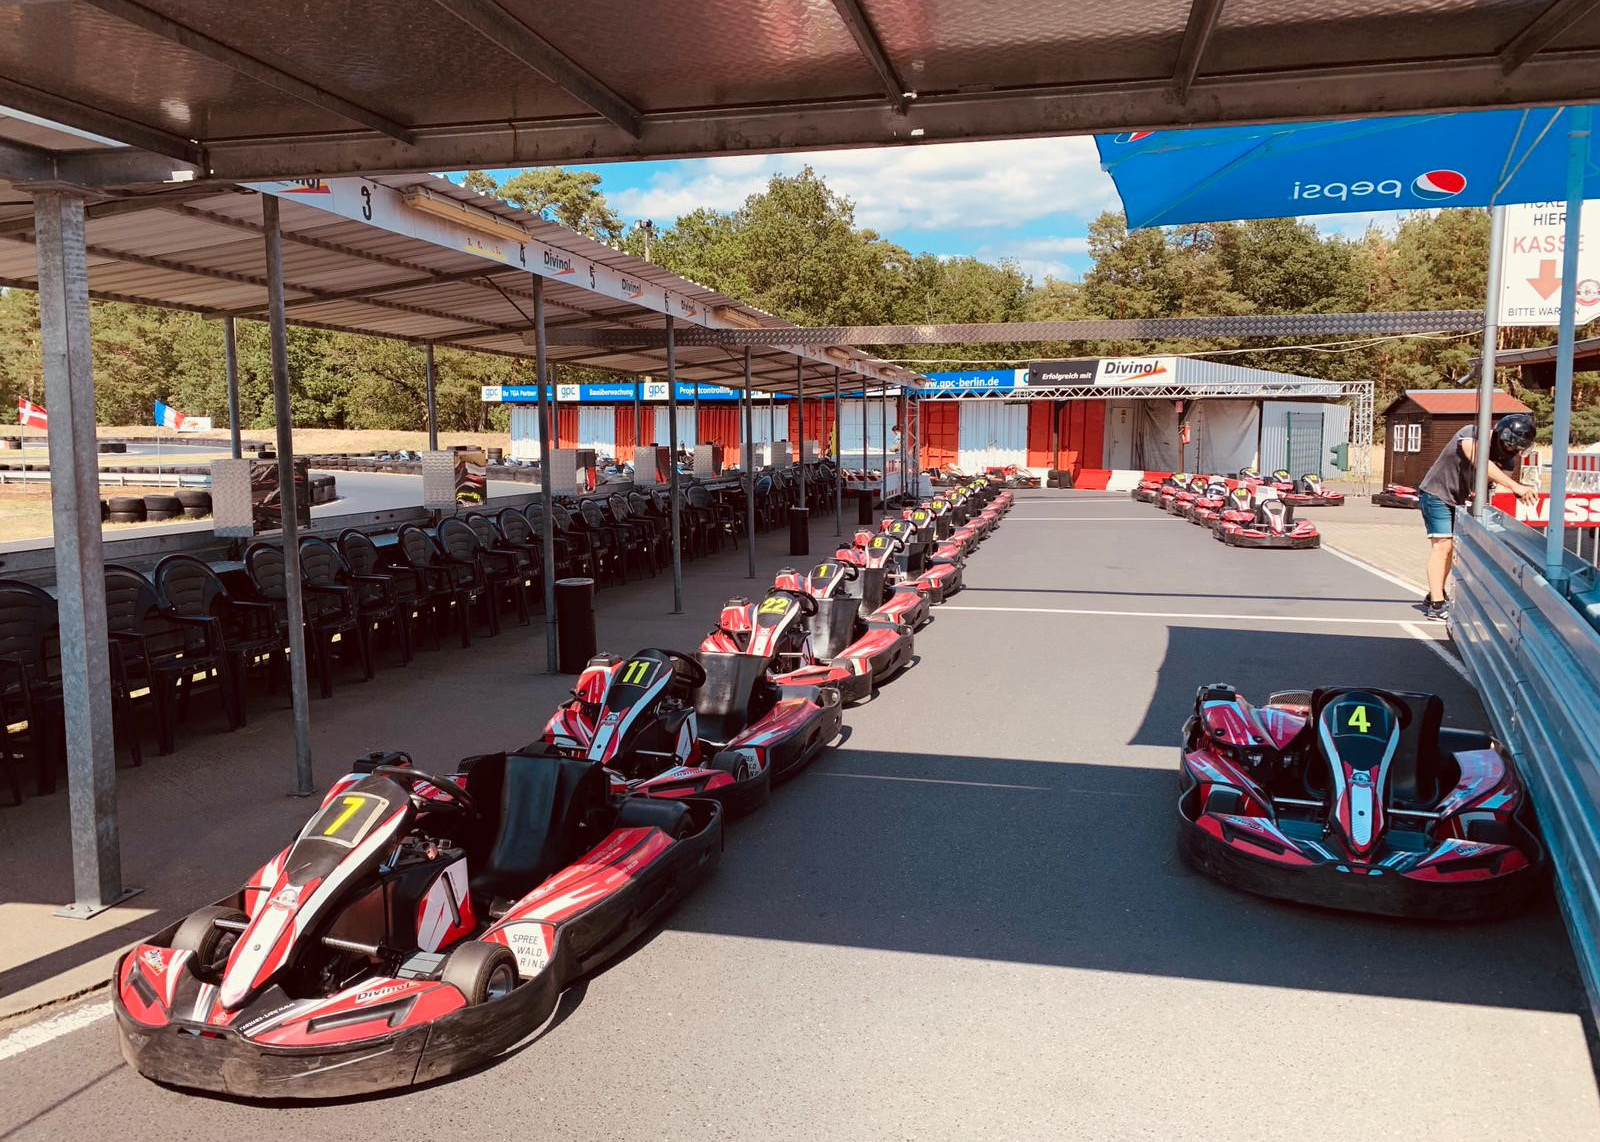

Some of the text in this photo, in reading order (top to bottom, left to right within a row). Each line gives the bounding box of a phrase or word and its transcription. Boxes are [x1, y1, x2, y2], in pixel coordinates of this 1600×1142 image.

[360, 185, 372, 221] 3
[1533, 212, 1567, 226] HIER
[519, 242, 526, 267] 4
[543, 248, 572, 270] Divinol
[1508, 306, 1581, 317] BITTE WARN
[1104, 360, 1160, 375] Divinol
[924, 376, 1000, 388] ww.gpc-berlin.de
[1041, 371, 1079, 381] Erfolgreich
[1079, 371, 1093, 380] mit
[560, 386, 577, 399] gpc
[648, 384, 734, 398] gpc Projetcontrolling
[914, 511, 926, 520] 18
[893, 523, 901, 532] 2
[873, 537, 883, 548] 8
[820, 565, 828, 578] 1
[759, 597, 789, 614] 22
[622, 660, 651, 684] 11
[1347, 705, 1372, 734] 4
[322, 796, 367, 836] 7
[511, 933, 540, 946] SPREE
[516, 945, 543, 958] WALD
[519, 957, 546, 970] RING
[357, 982, 411, 1001] Divinol
